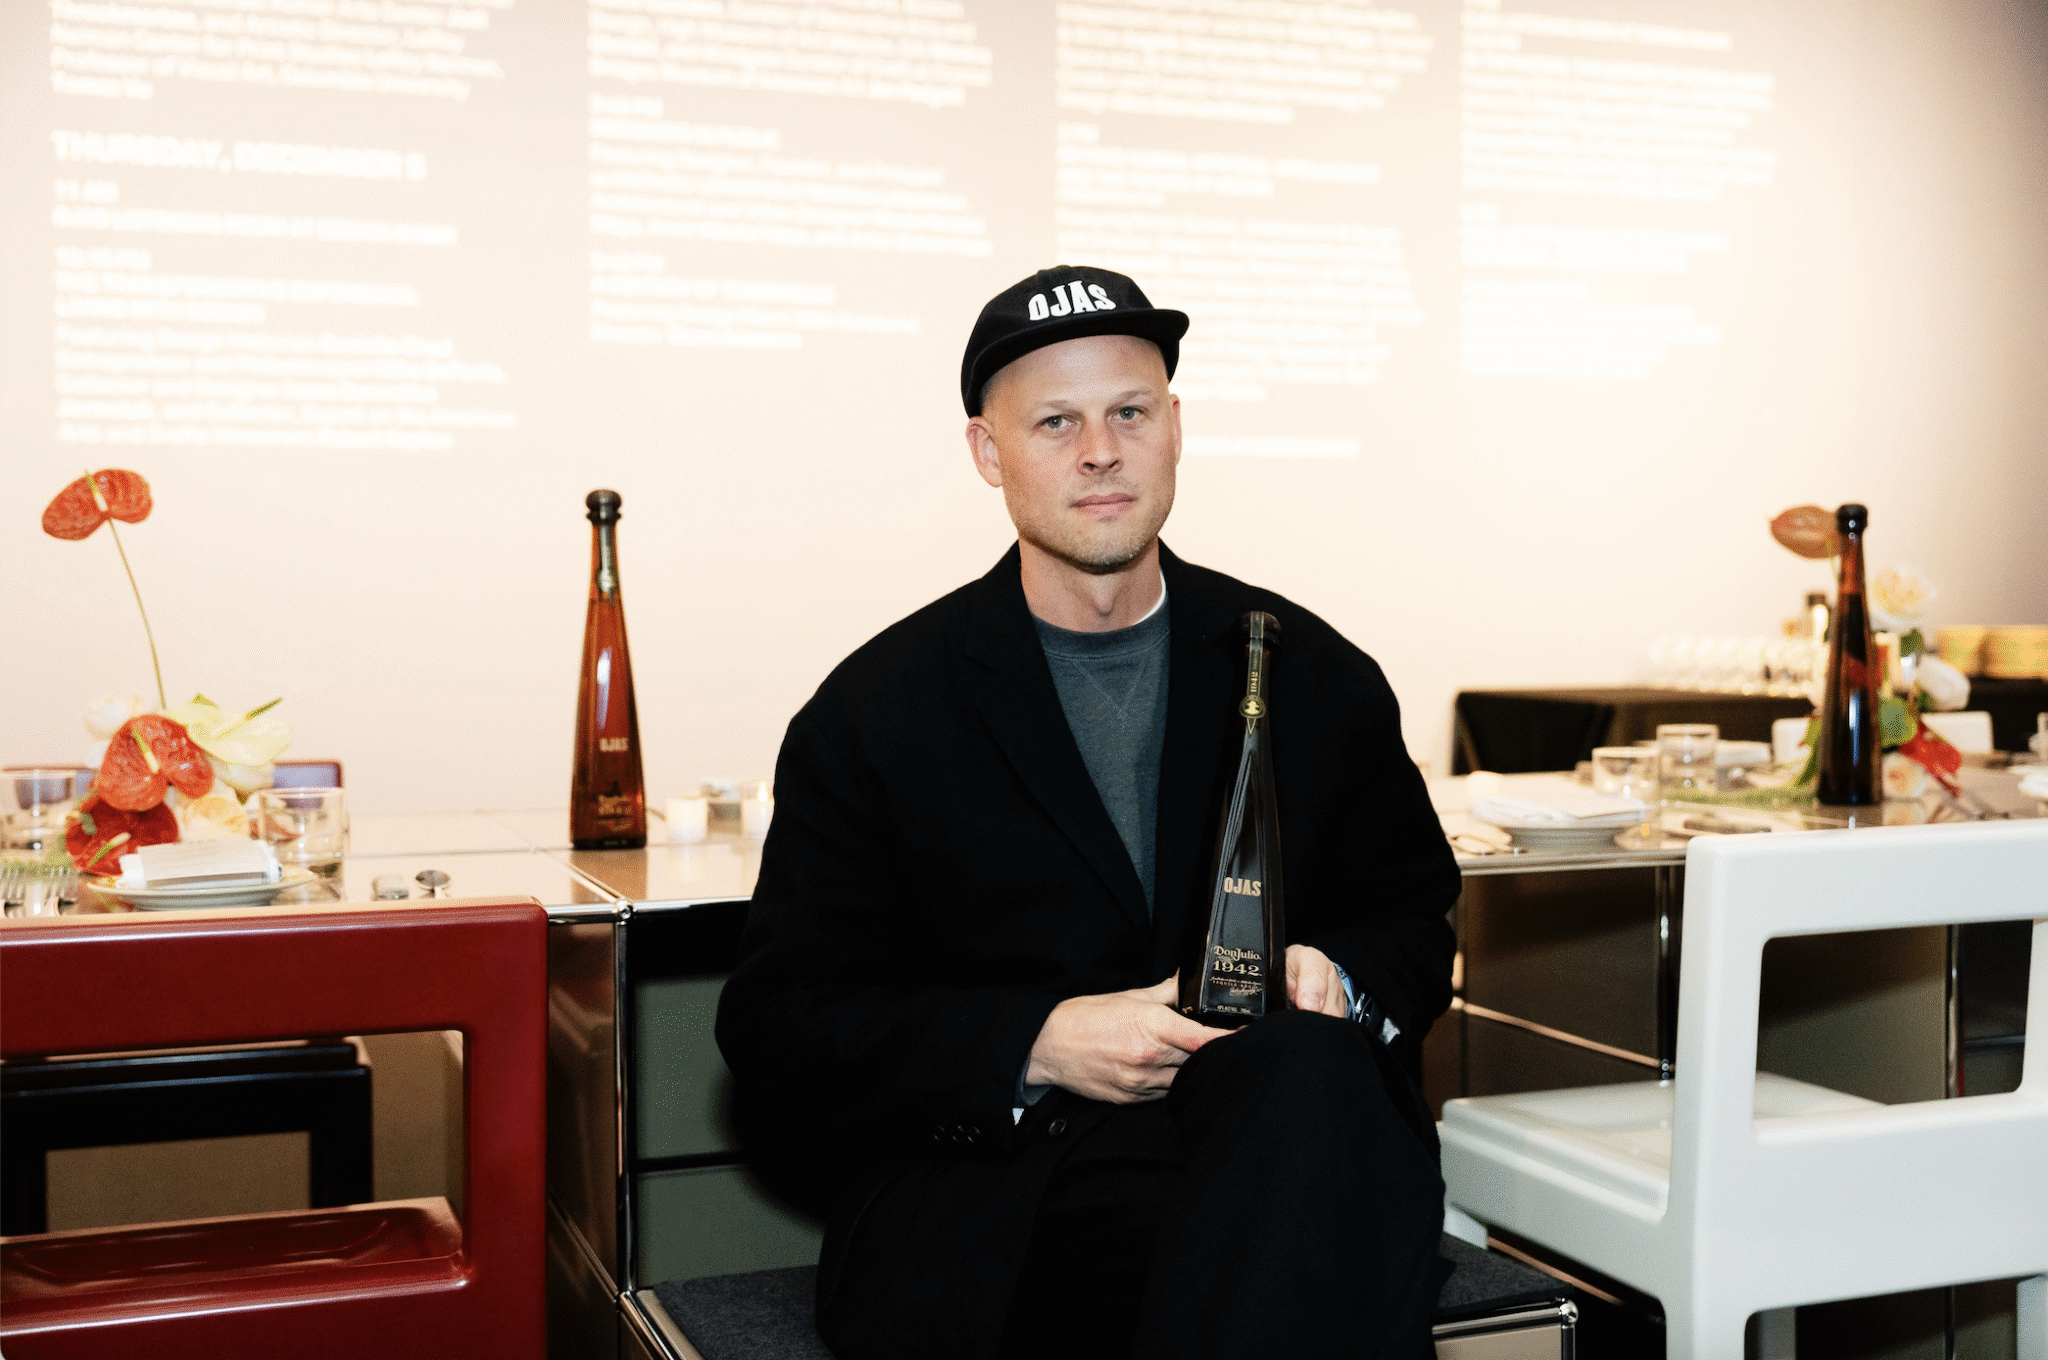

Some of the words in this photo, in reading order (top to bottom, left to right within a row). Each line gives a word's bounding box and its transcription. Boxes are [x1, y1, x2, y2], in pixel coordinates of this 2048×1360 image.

[1028, 280, 1116, 321] OJAS
[1224, 876, 1261, 897] OJAS
[1213, 960, 1262, 977] 1942
